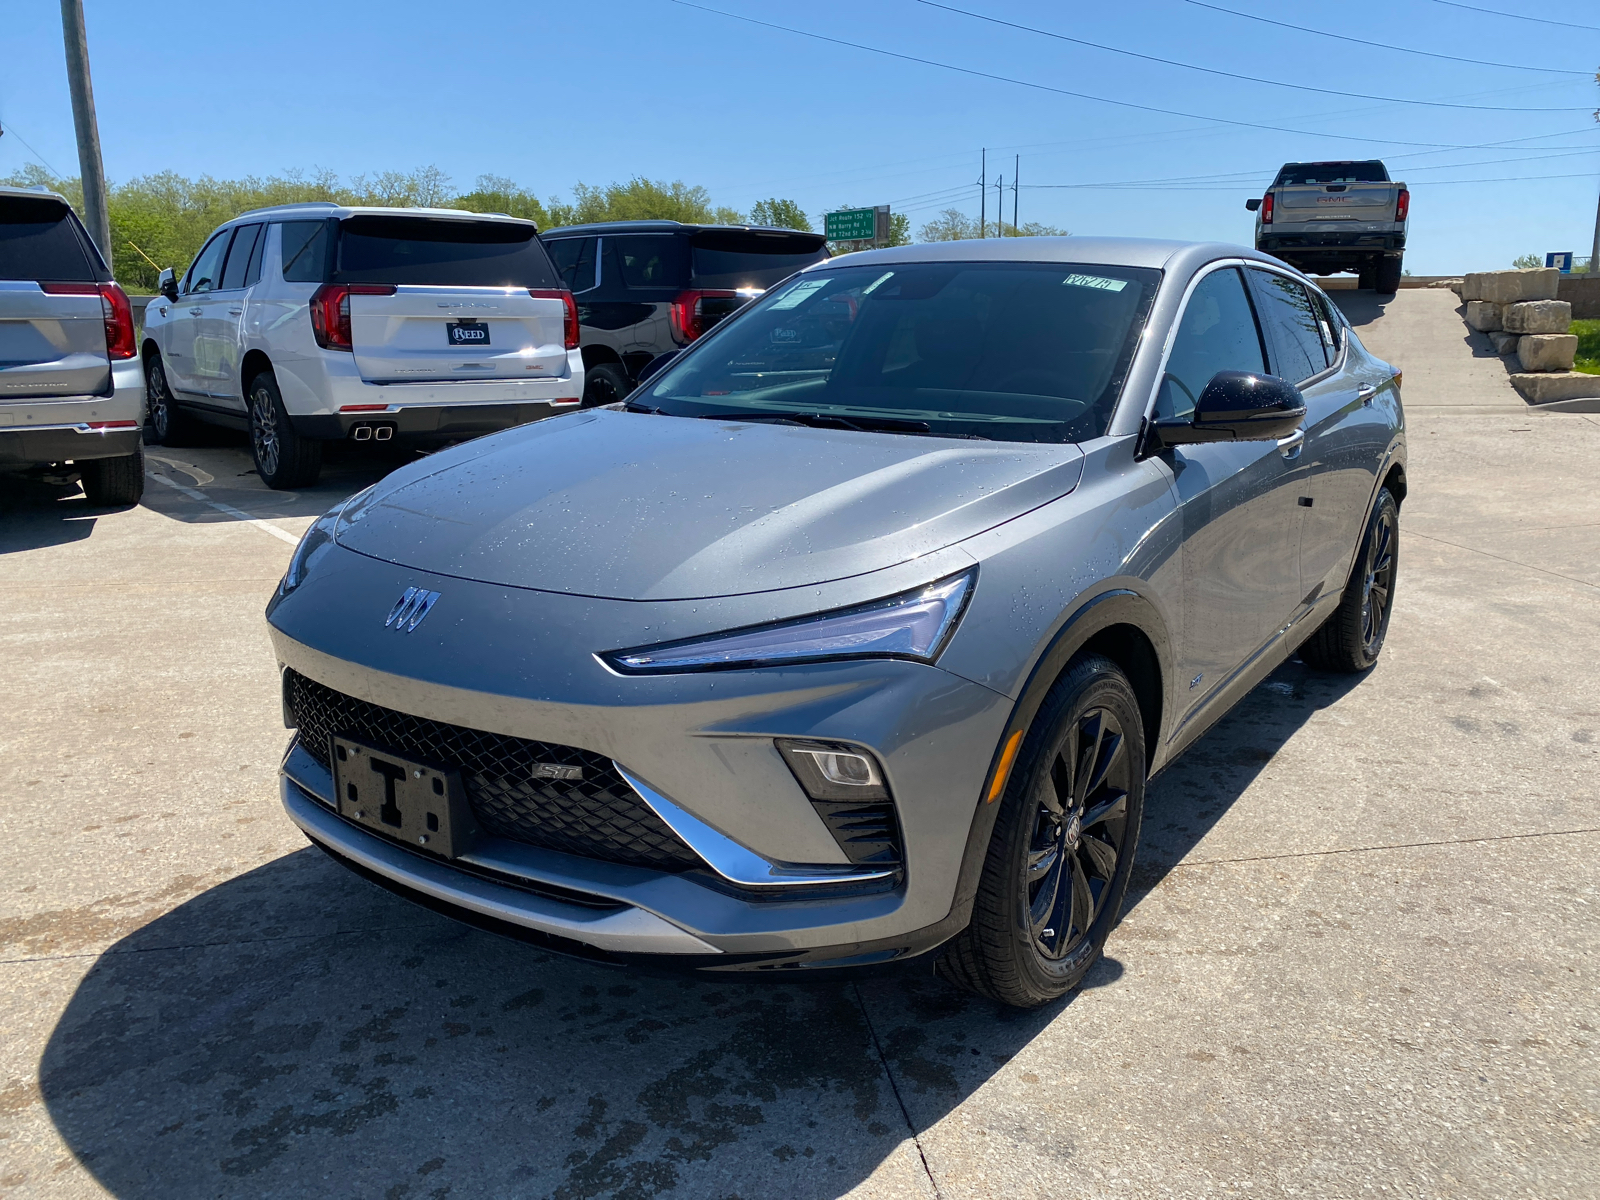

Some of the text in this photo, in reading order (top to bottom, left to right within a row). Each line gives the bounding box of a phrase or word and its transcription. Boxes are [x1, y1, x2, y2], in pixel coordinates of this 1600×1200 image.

[1316, 195, 1353, 204] GMC
[452, 327, 485, 341] REED
[538, 766, 579, 779] ST
